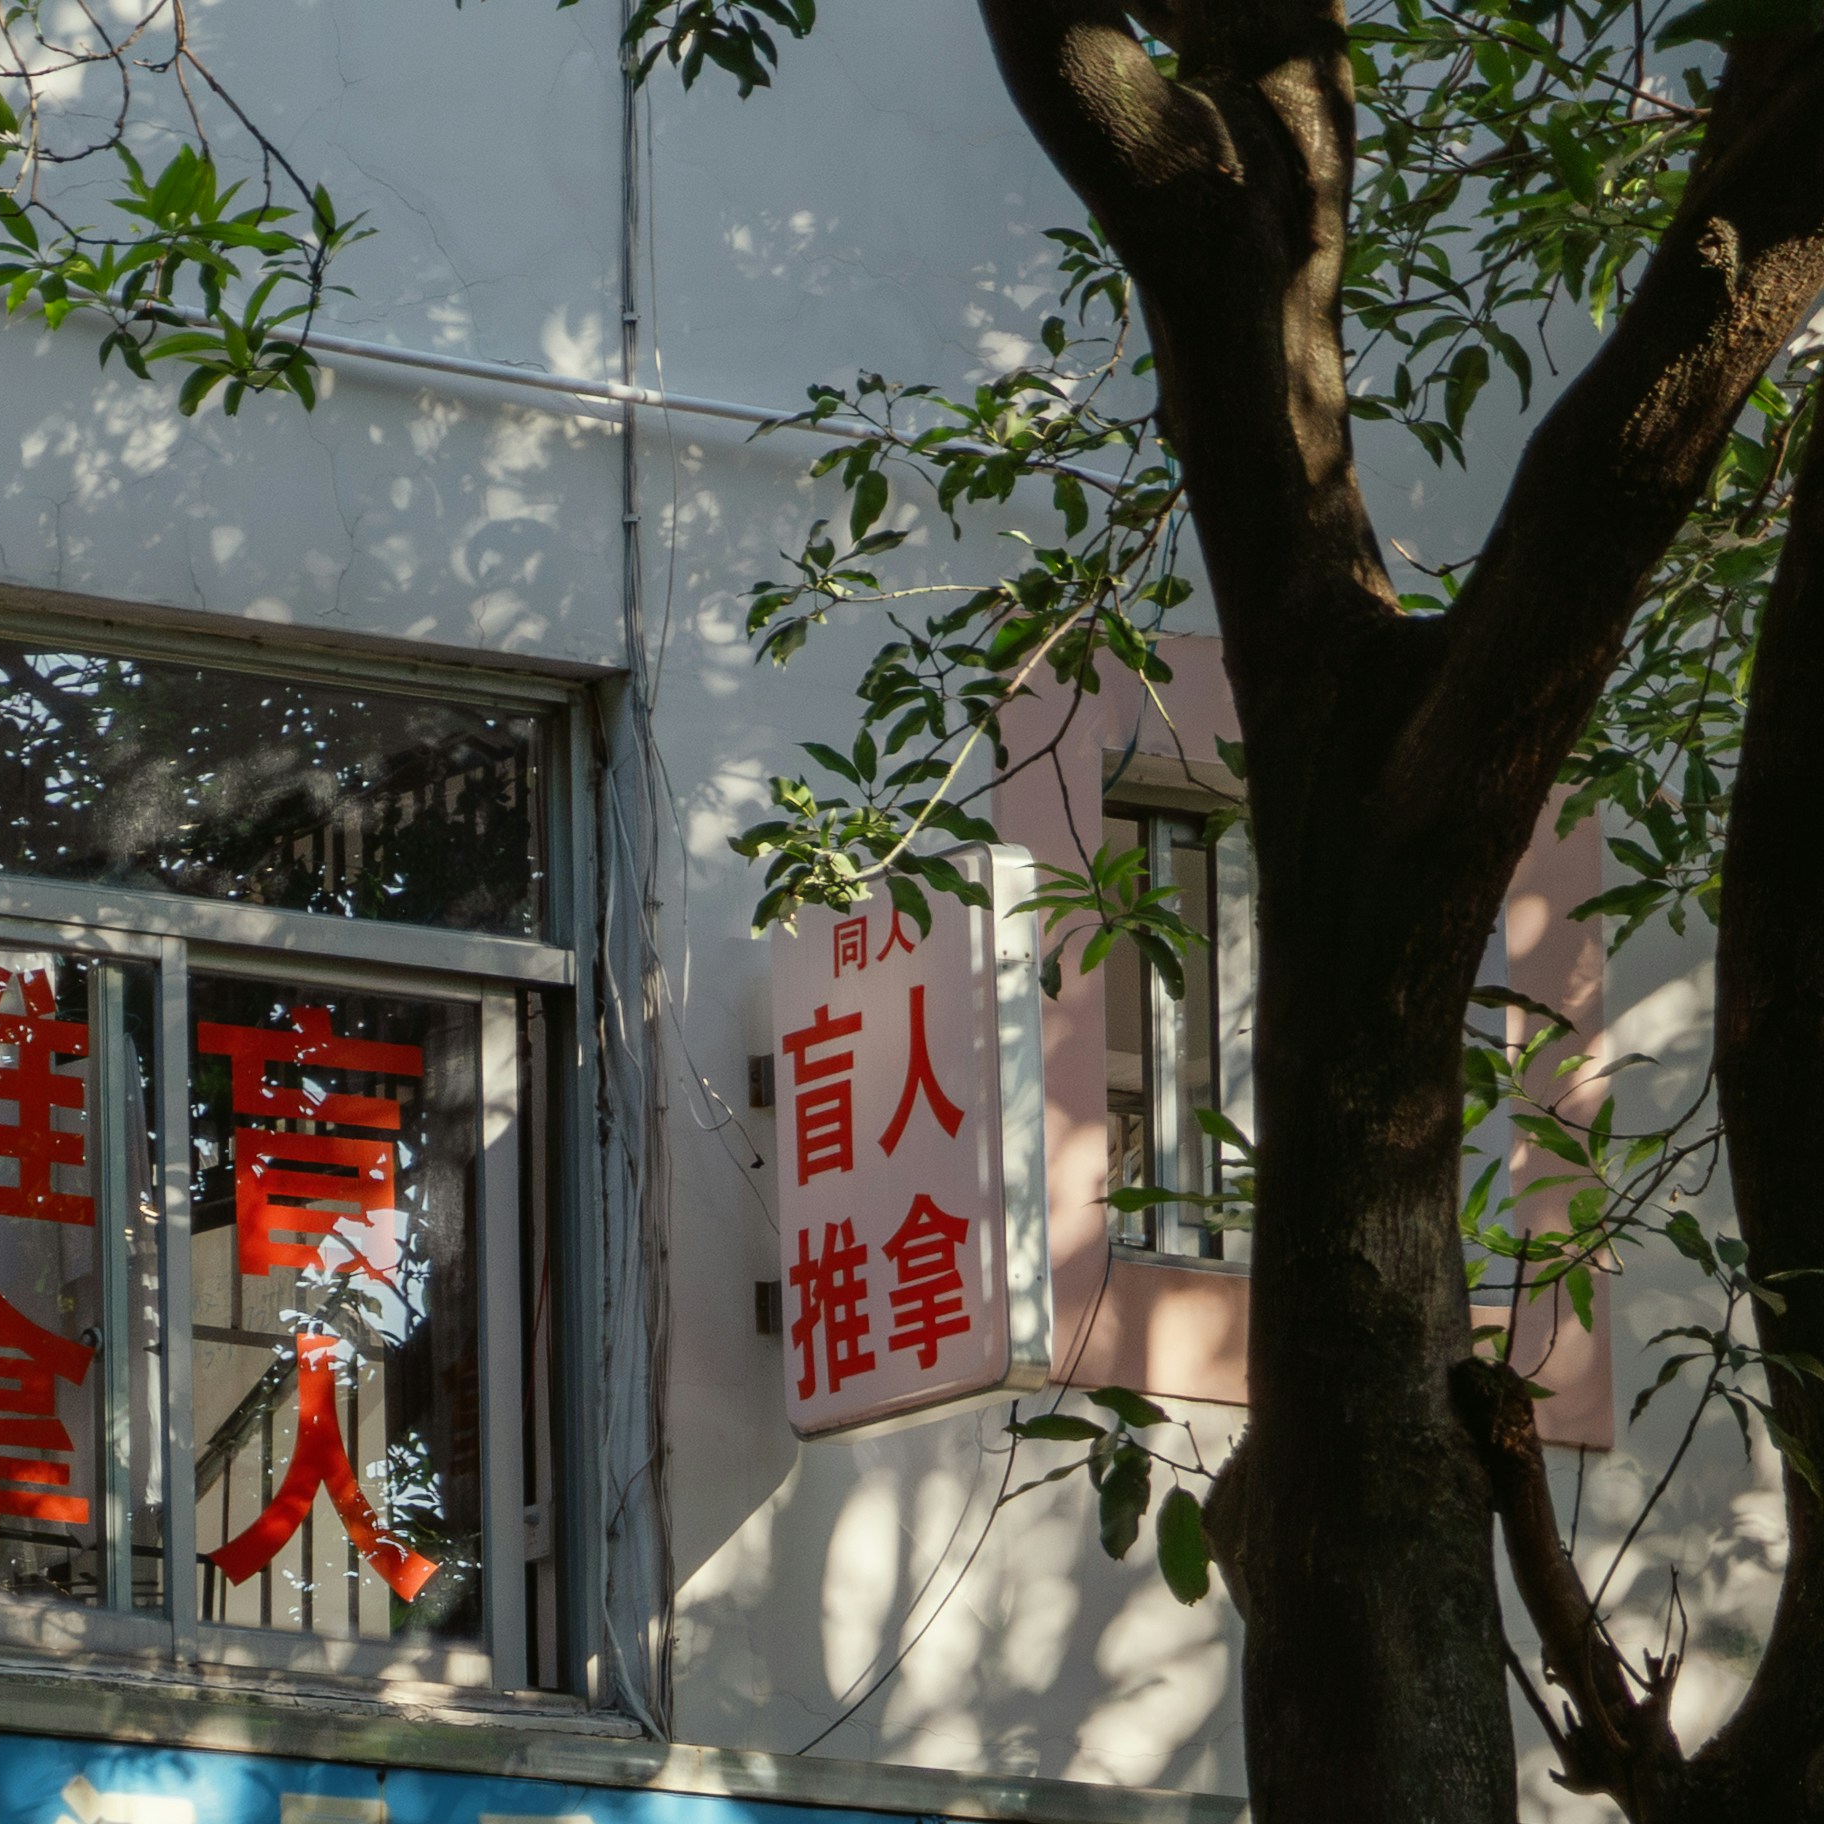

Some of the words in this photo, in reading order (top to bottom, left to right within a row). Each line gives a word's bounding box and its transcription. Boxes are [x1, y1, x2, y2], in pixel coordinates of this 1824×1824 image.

[782, 984, 966, 1188] 盲人
[197, 1006, 441, 1603] 盲人
[788, 1192, 977, 1401] 推拿
